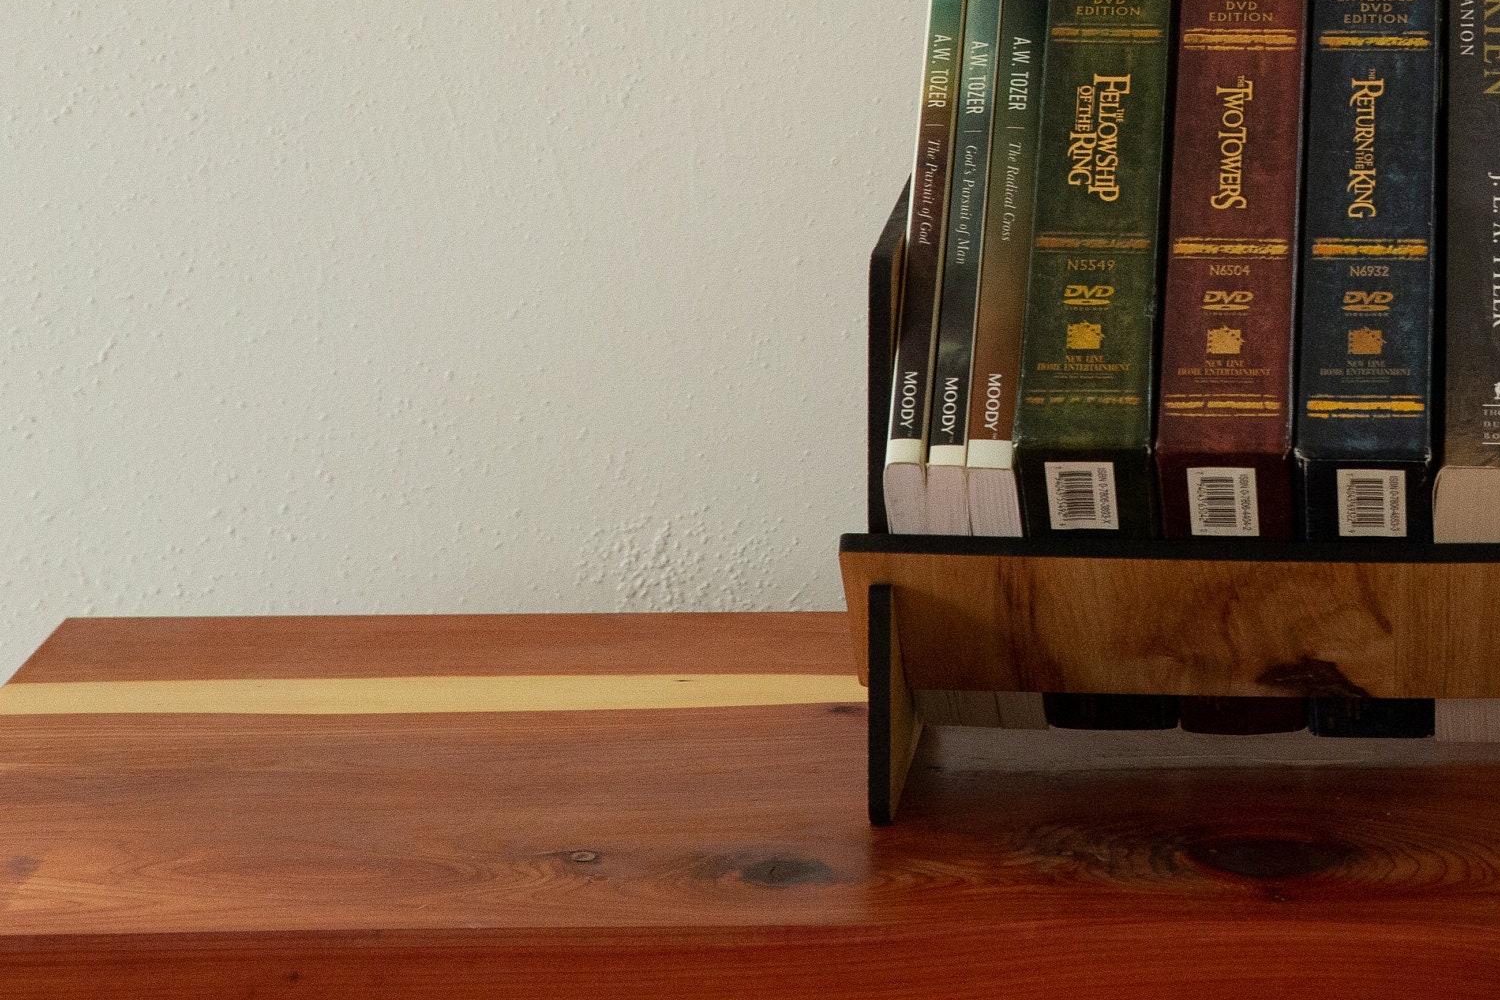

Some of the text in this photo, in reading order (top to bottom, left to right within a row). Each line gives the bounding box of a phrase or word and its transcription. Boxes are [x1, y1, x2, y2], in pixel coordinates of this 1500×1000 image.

[1076, 5, 1141, 16] EDITION
[1226, 1, 1257, 11] DVD
[1360, 3, 1393, 13] DVD
[1209, 12, 1273, 22] EDITION
[1343, 14, 1408, 24] EDITION
[927, 34, 952, 108] A.W. TOZER
[966, 40, 989, 114] A.W. TOZER
[1008, 36, 1032, 111] A.W. TOZER
[1237, 75, 1245, 87] THE
[1115, 108, 1125, 123] THE
[1067, 85, 1097, 186] OF THE RING
[1088, 73, 1132, 202] FELLOWSHIP
[1210, 80, 1254, 210] TWO TOWERS
[1346, 78, 1385, 219] RETURN OF THE KING
[918, 140, 941, 245] The Pursuit of God
[960, 179, 975, 220] Pursuit
[1002, 142, 1021, 241] The Radical Cross
[955, 223, 970, 236] of
[956, 238, 970, 265] Man
[1067, 260, 1116, 271] N5549
[1209, 265, 1251, 276] N6504
[1350, 265, 1390, 277] N6932
[1064, 285, 1115, 298] DVD
[1203, 290, 1254, 304] DVD
[1343, 291, 1395, 305] DVD
[900, 371, 918, 429] MOODY
[941, 377, 959, 435] MOODY
[984, 373, 1002, 432] MOODY
